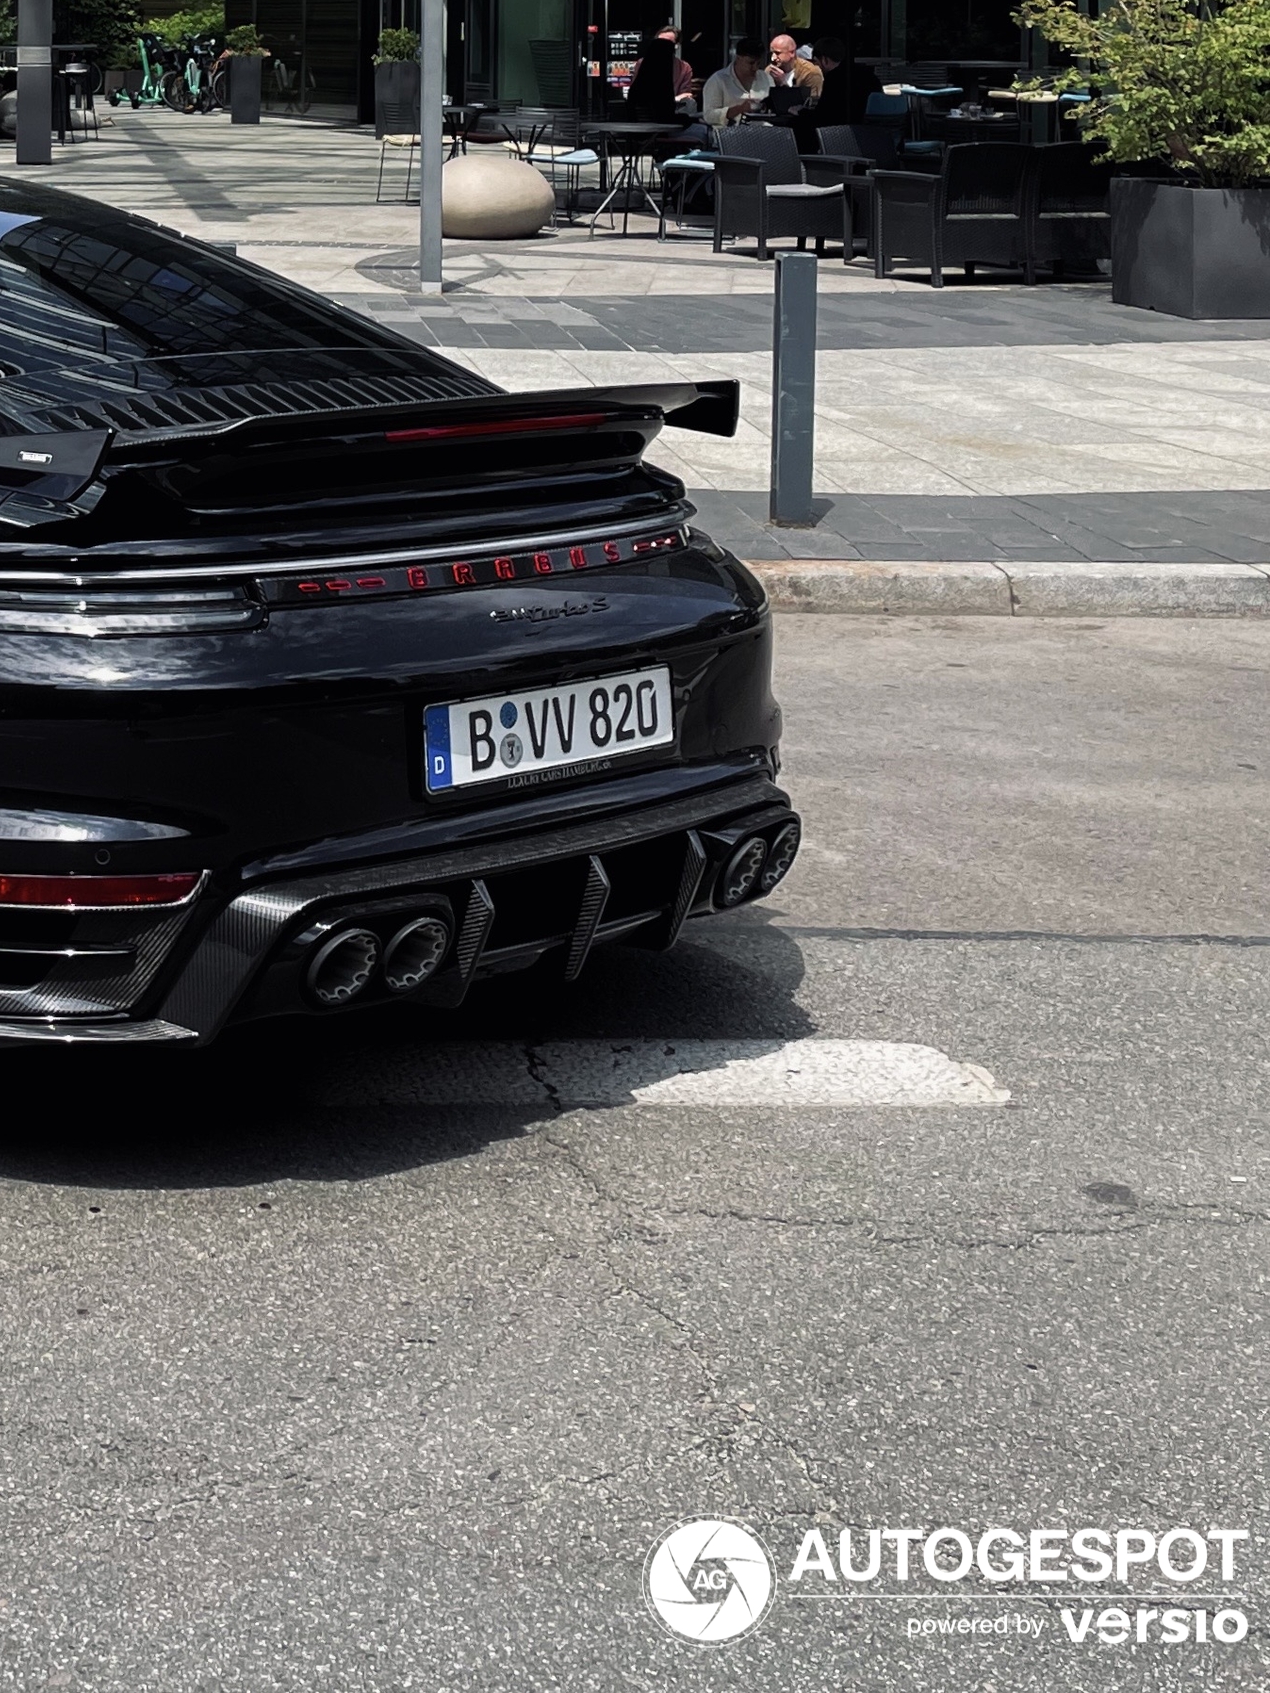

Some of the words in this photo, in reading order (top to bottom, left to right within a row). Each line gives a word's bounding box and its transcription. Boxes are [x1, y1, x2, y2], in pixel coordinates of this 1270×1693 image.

[407, 542, 620, 589] BRABUS
[468, 709, 497, 773] B
[524, 693, 577, 760] VV
[589, 678, 659, 748] 820
[434, 756, 446, 775] D
